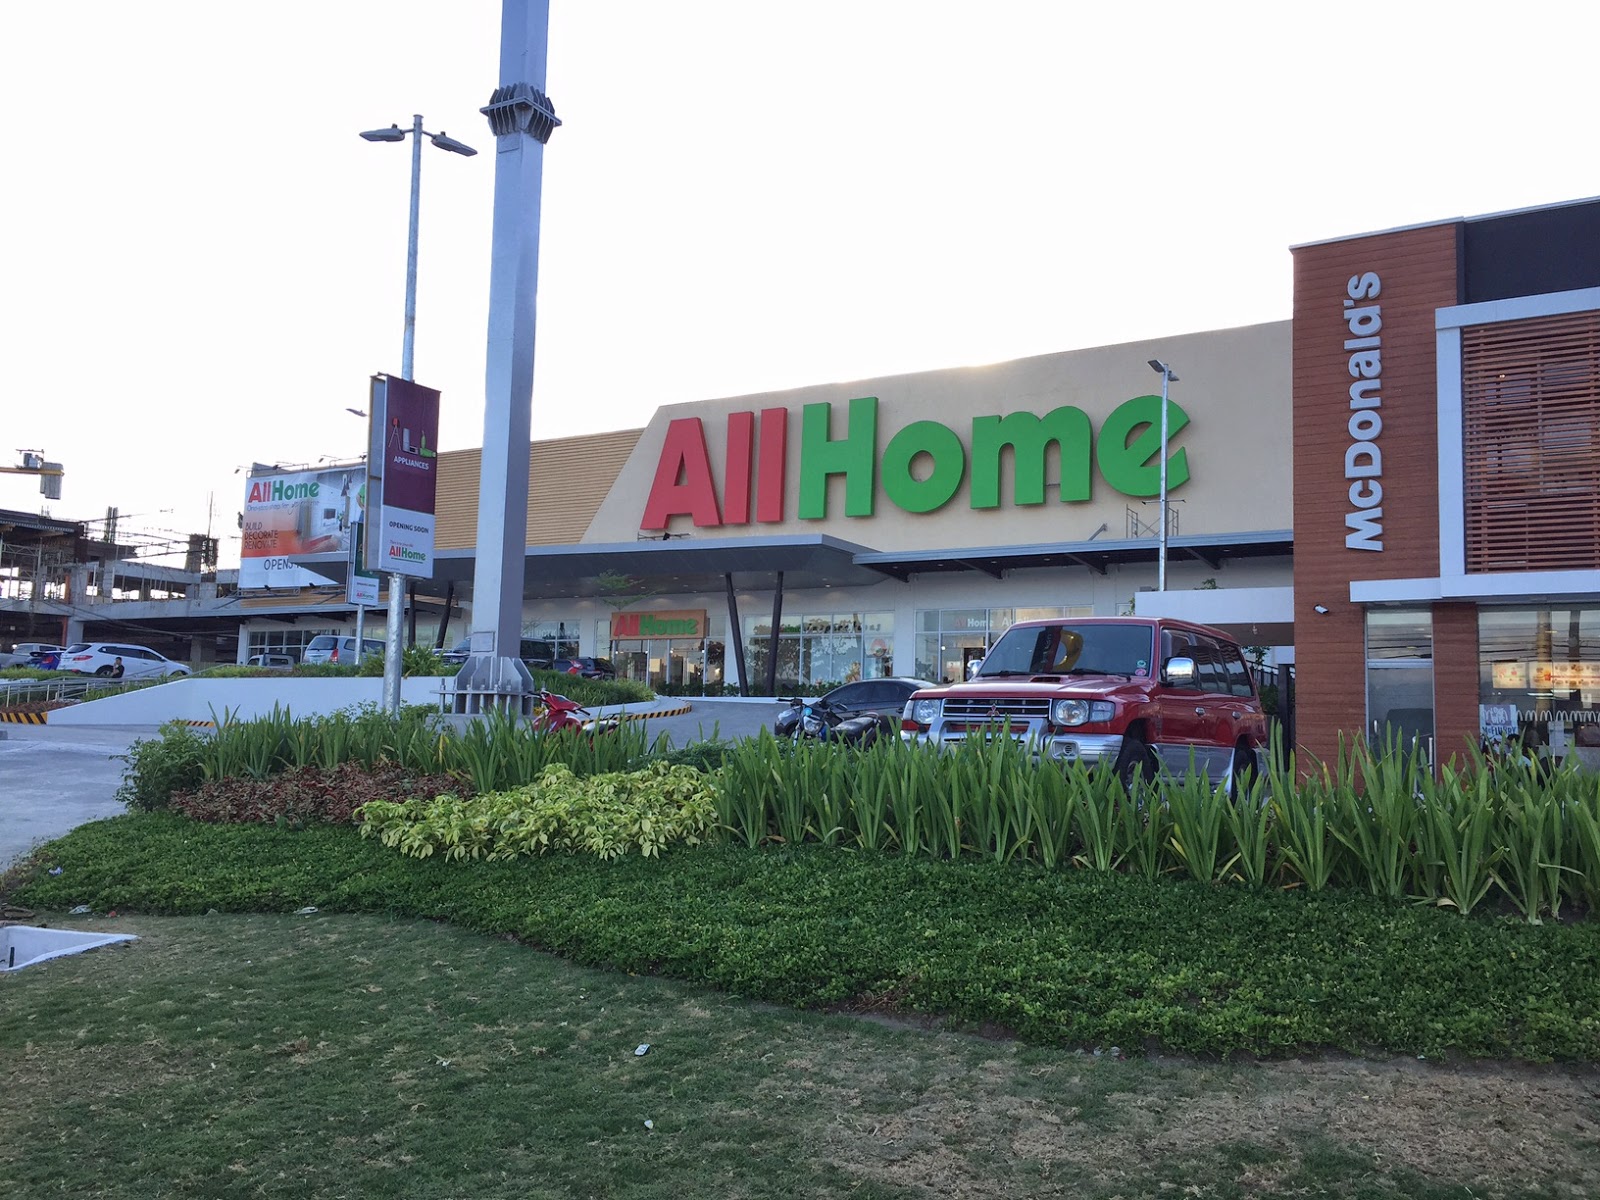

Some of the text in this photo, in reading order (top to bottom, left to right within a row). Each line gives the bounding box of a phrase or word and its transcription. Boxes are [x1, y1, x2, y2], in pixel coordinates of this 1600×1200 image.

[1343, 271, 1383, 551] McDonald's
[393, 456, 429, 470] APPLIANCES
[640, 395, 1191, 530] AllHome
[248, 480, 320, 503] AllHome
[245, 522, 263, 531] BUILD
[389, 521, 429, 534] OPENING SOON
[244, 530, 279, 540] DECORATE
[244, 540, 278, 549] RENOVATE
[389, 545, 427, 561] AllHome
[613, 614, 698, 636] AllHome
